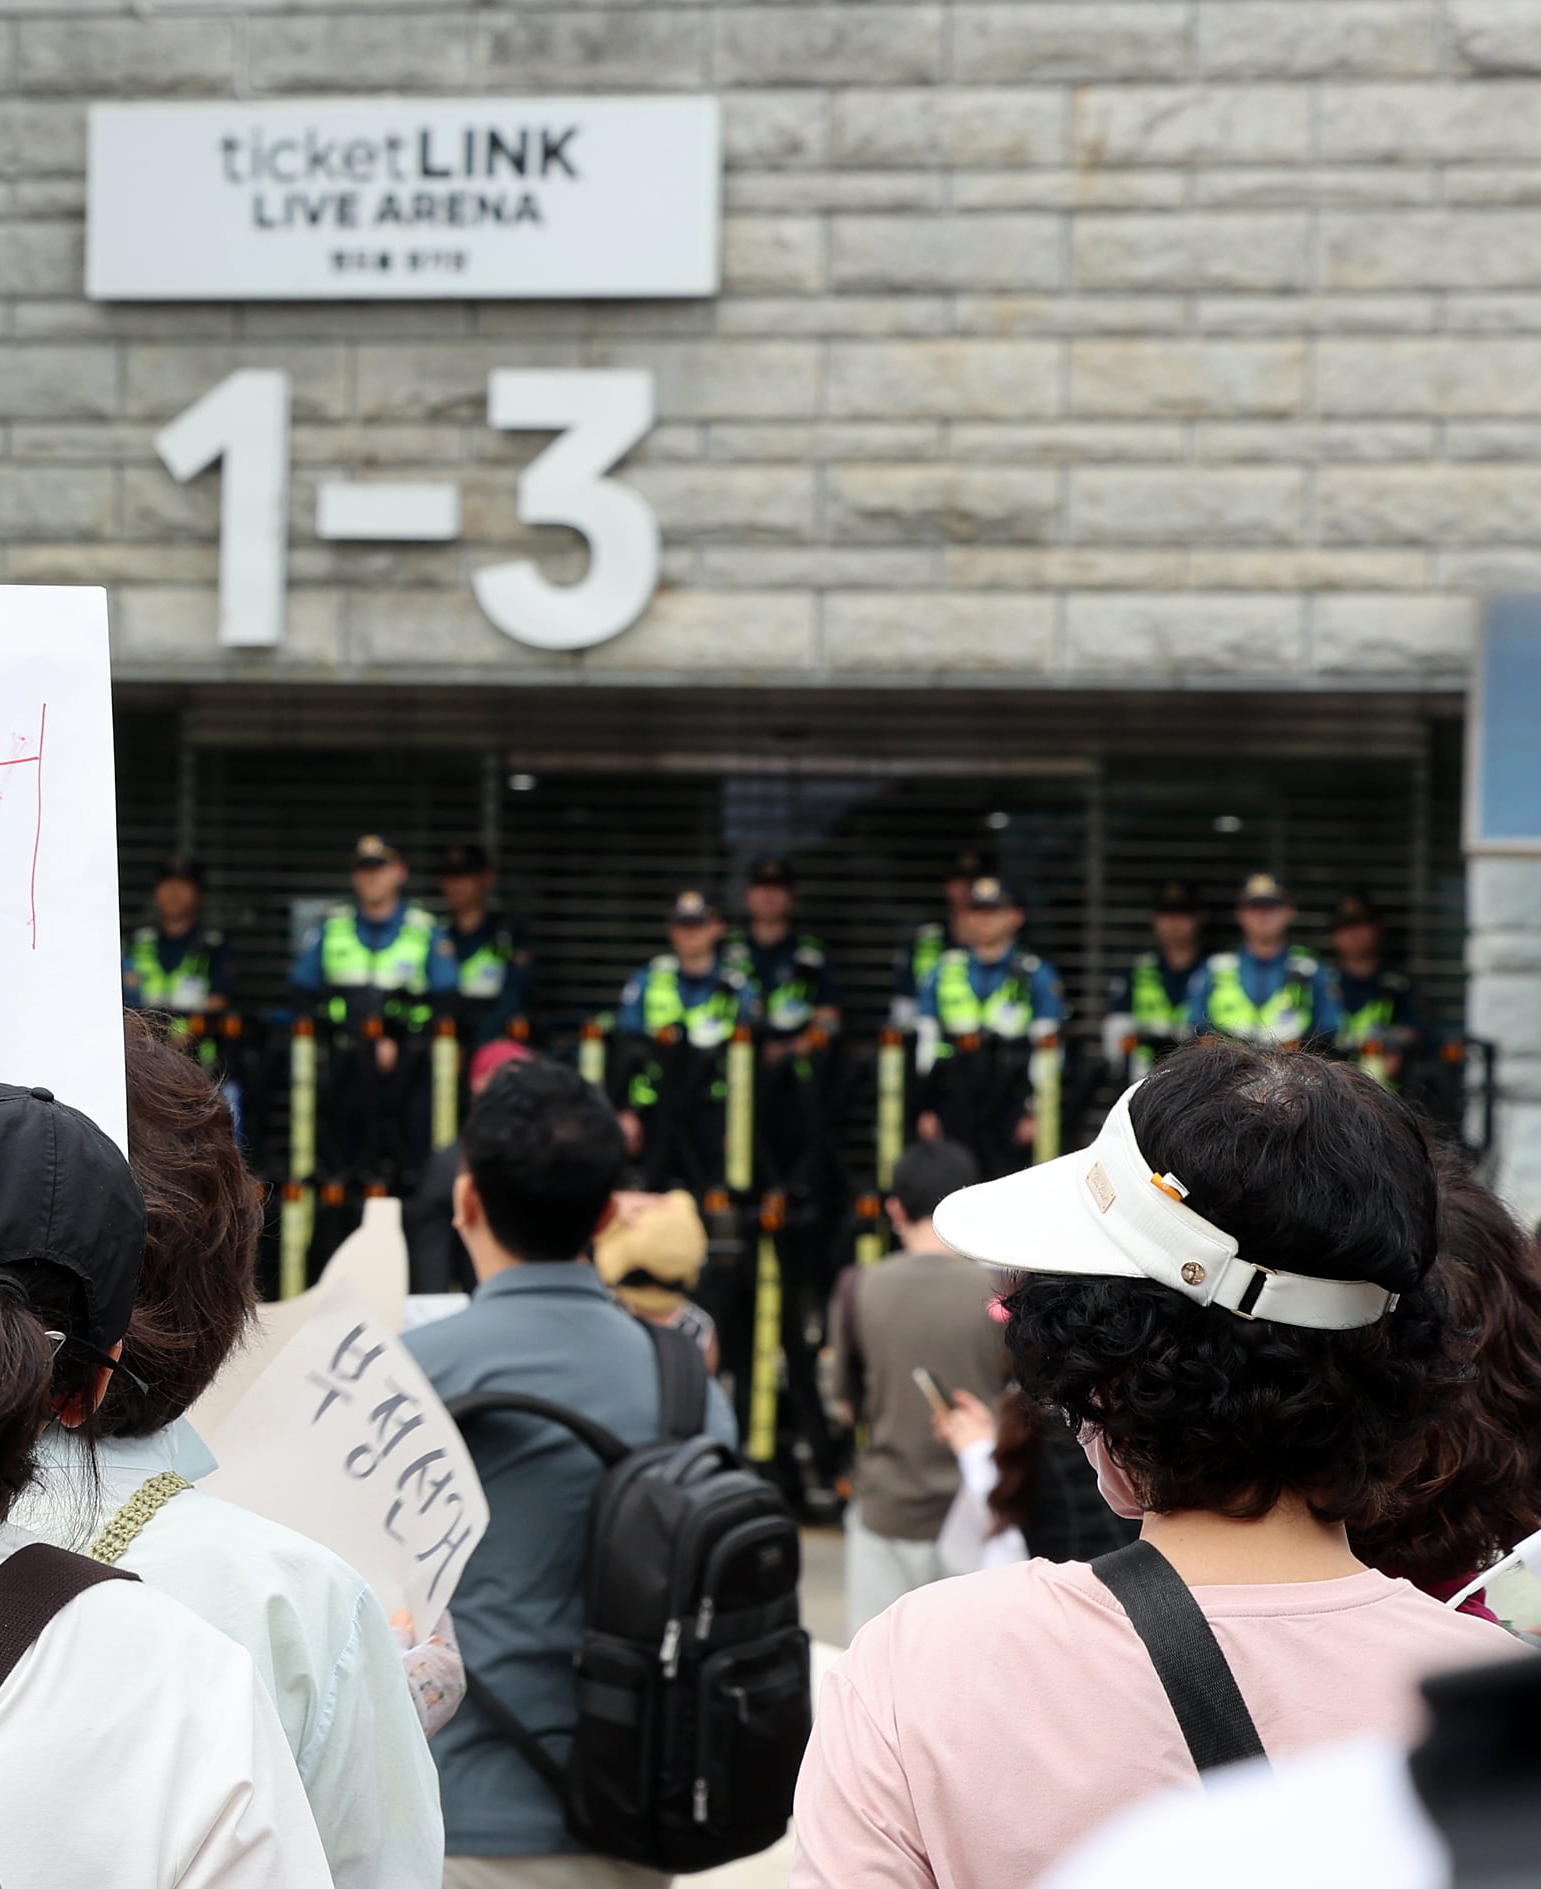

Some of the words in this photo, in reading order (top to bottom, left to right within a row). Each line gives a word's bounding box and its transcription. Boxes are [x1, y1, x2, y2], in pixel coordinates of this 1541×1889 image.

[219, 124, 579, 184] ticketLINK
[252, 192, 359, 231] LIVE
[373, 191, 543, 229] ARENA
[153, 368, 661, 650] 1-3
[306, 1322, 472, 1603] 부정선거
